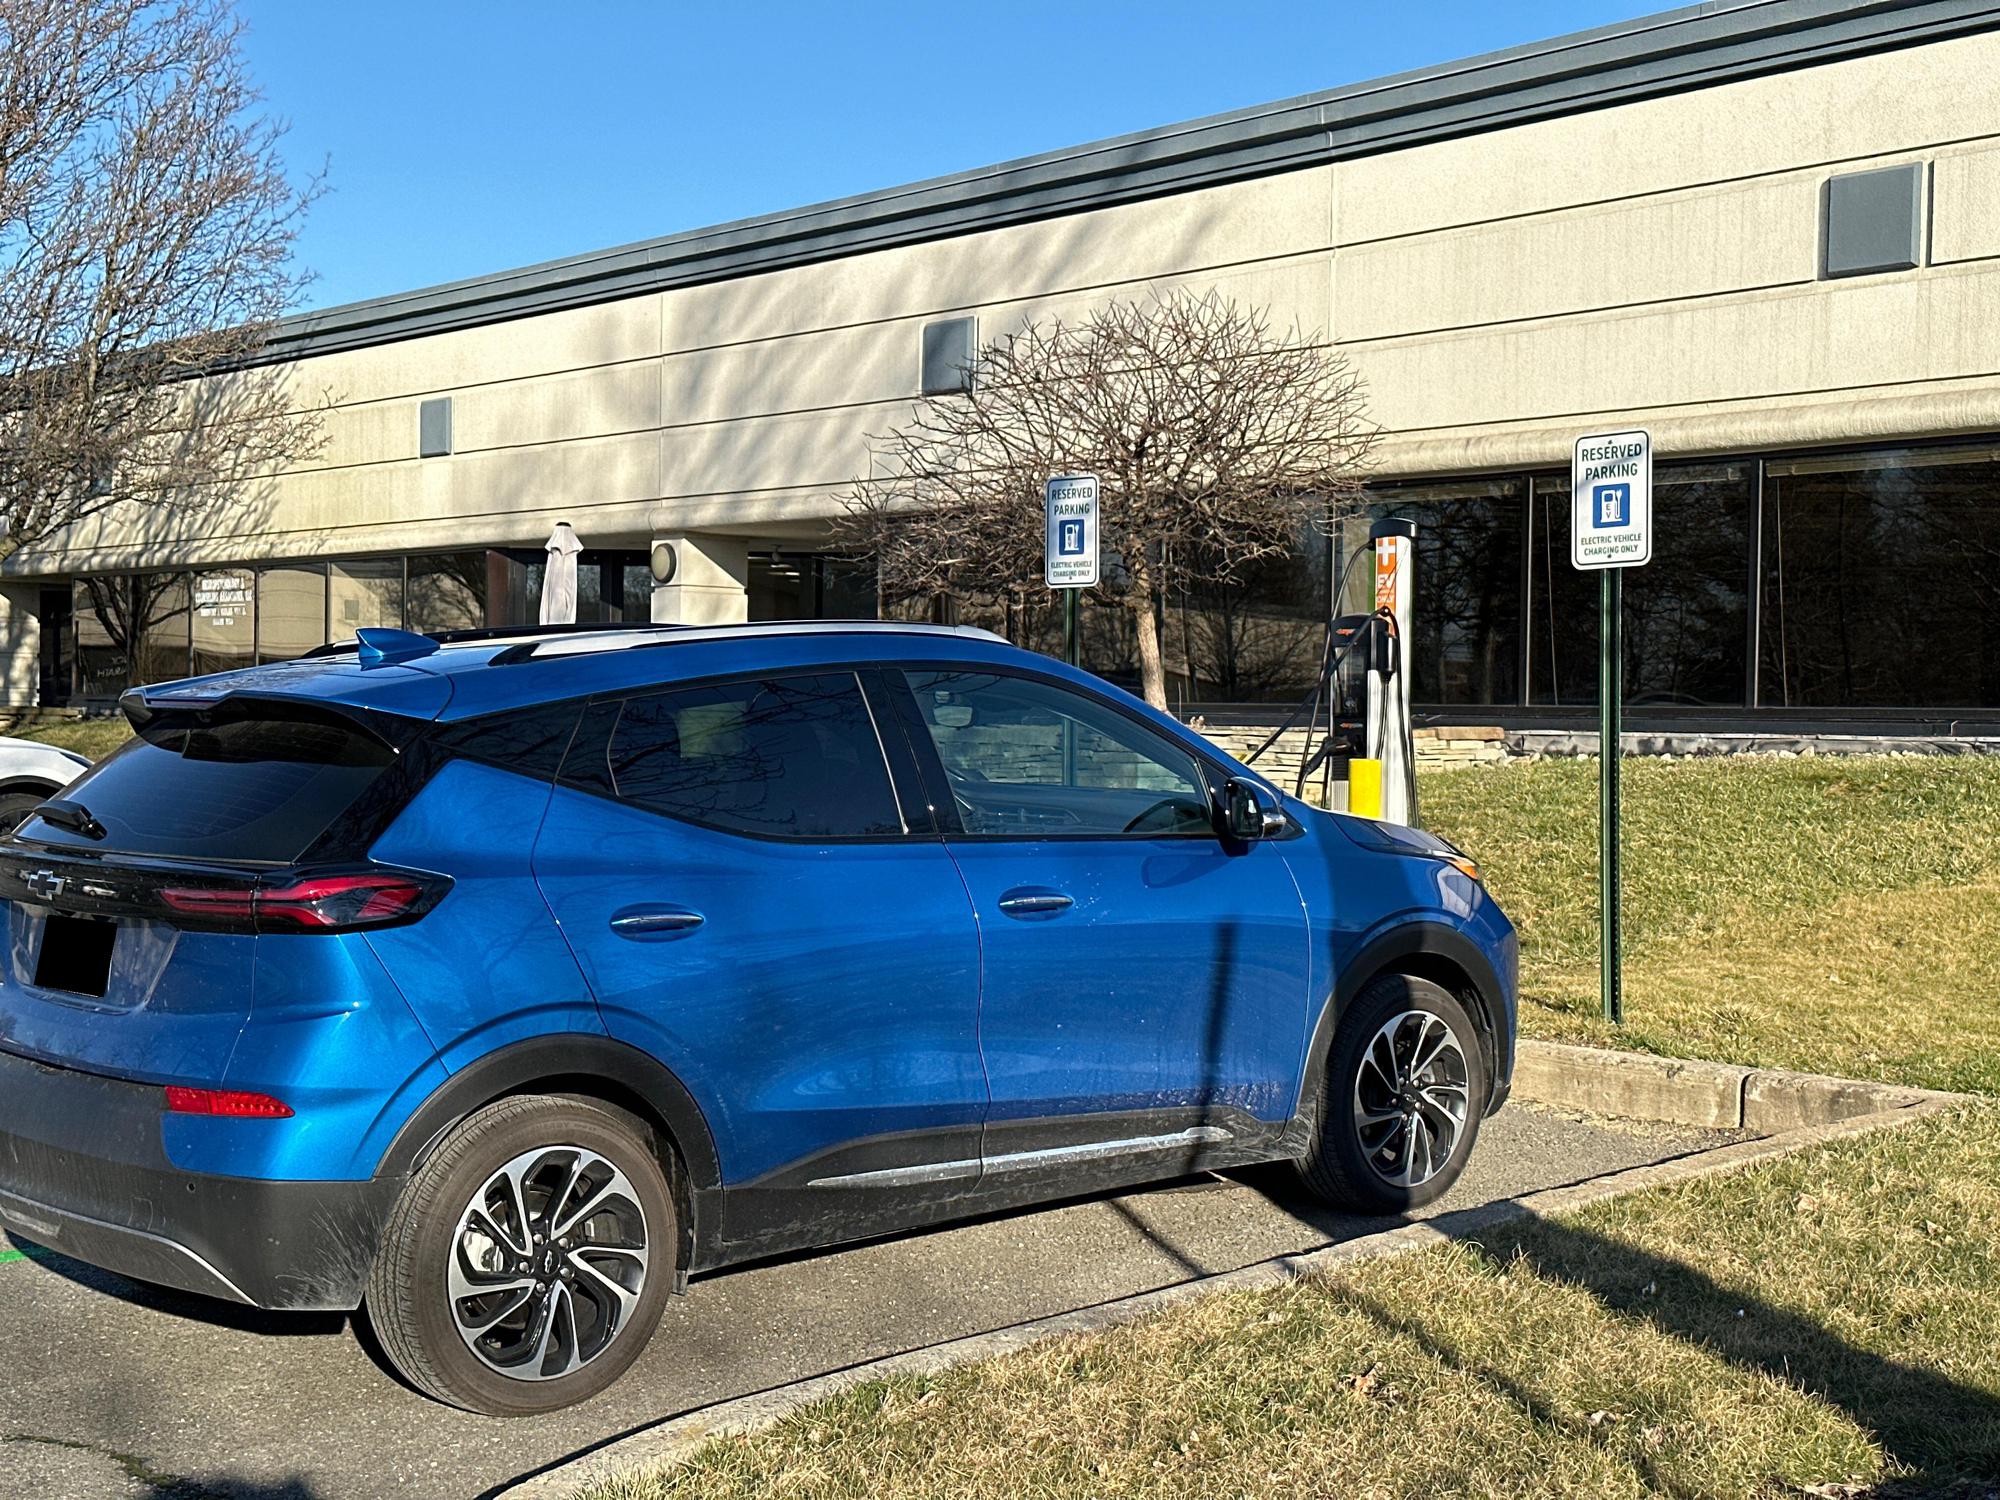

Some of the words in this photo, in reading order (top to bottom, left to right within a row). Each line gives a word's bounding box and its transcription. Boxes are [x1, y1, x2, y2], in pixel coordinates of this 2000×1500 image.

[1582, 443, 1642, 462] RESERVED
[1586, 463, 1638, 480] PARKING
[1052, 487, 1093, 500] RESERVED
[1054, 504, 1090, 516] PARKING
[1581, 535, 1612, 545] ELECTRIC
[1614, 533, 1642, 543] VEHICLE
[1584, 545, 1619, 556] CHARGING
[1621, 544, 1638, 553] ONLY
[1051, 561, 1072, 569] ELECTRIC
[1073, 560, 1092, 568] VEHICLE
[1053, 570, 1077, 578] CHARGING
[1078, 569, 1090, 577] ONLY
